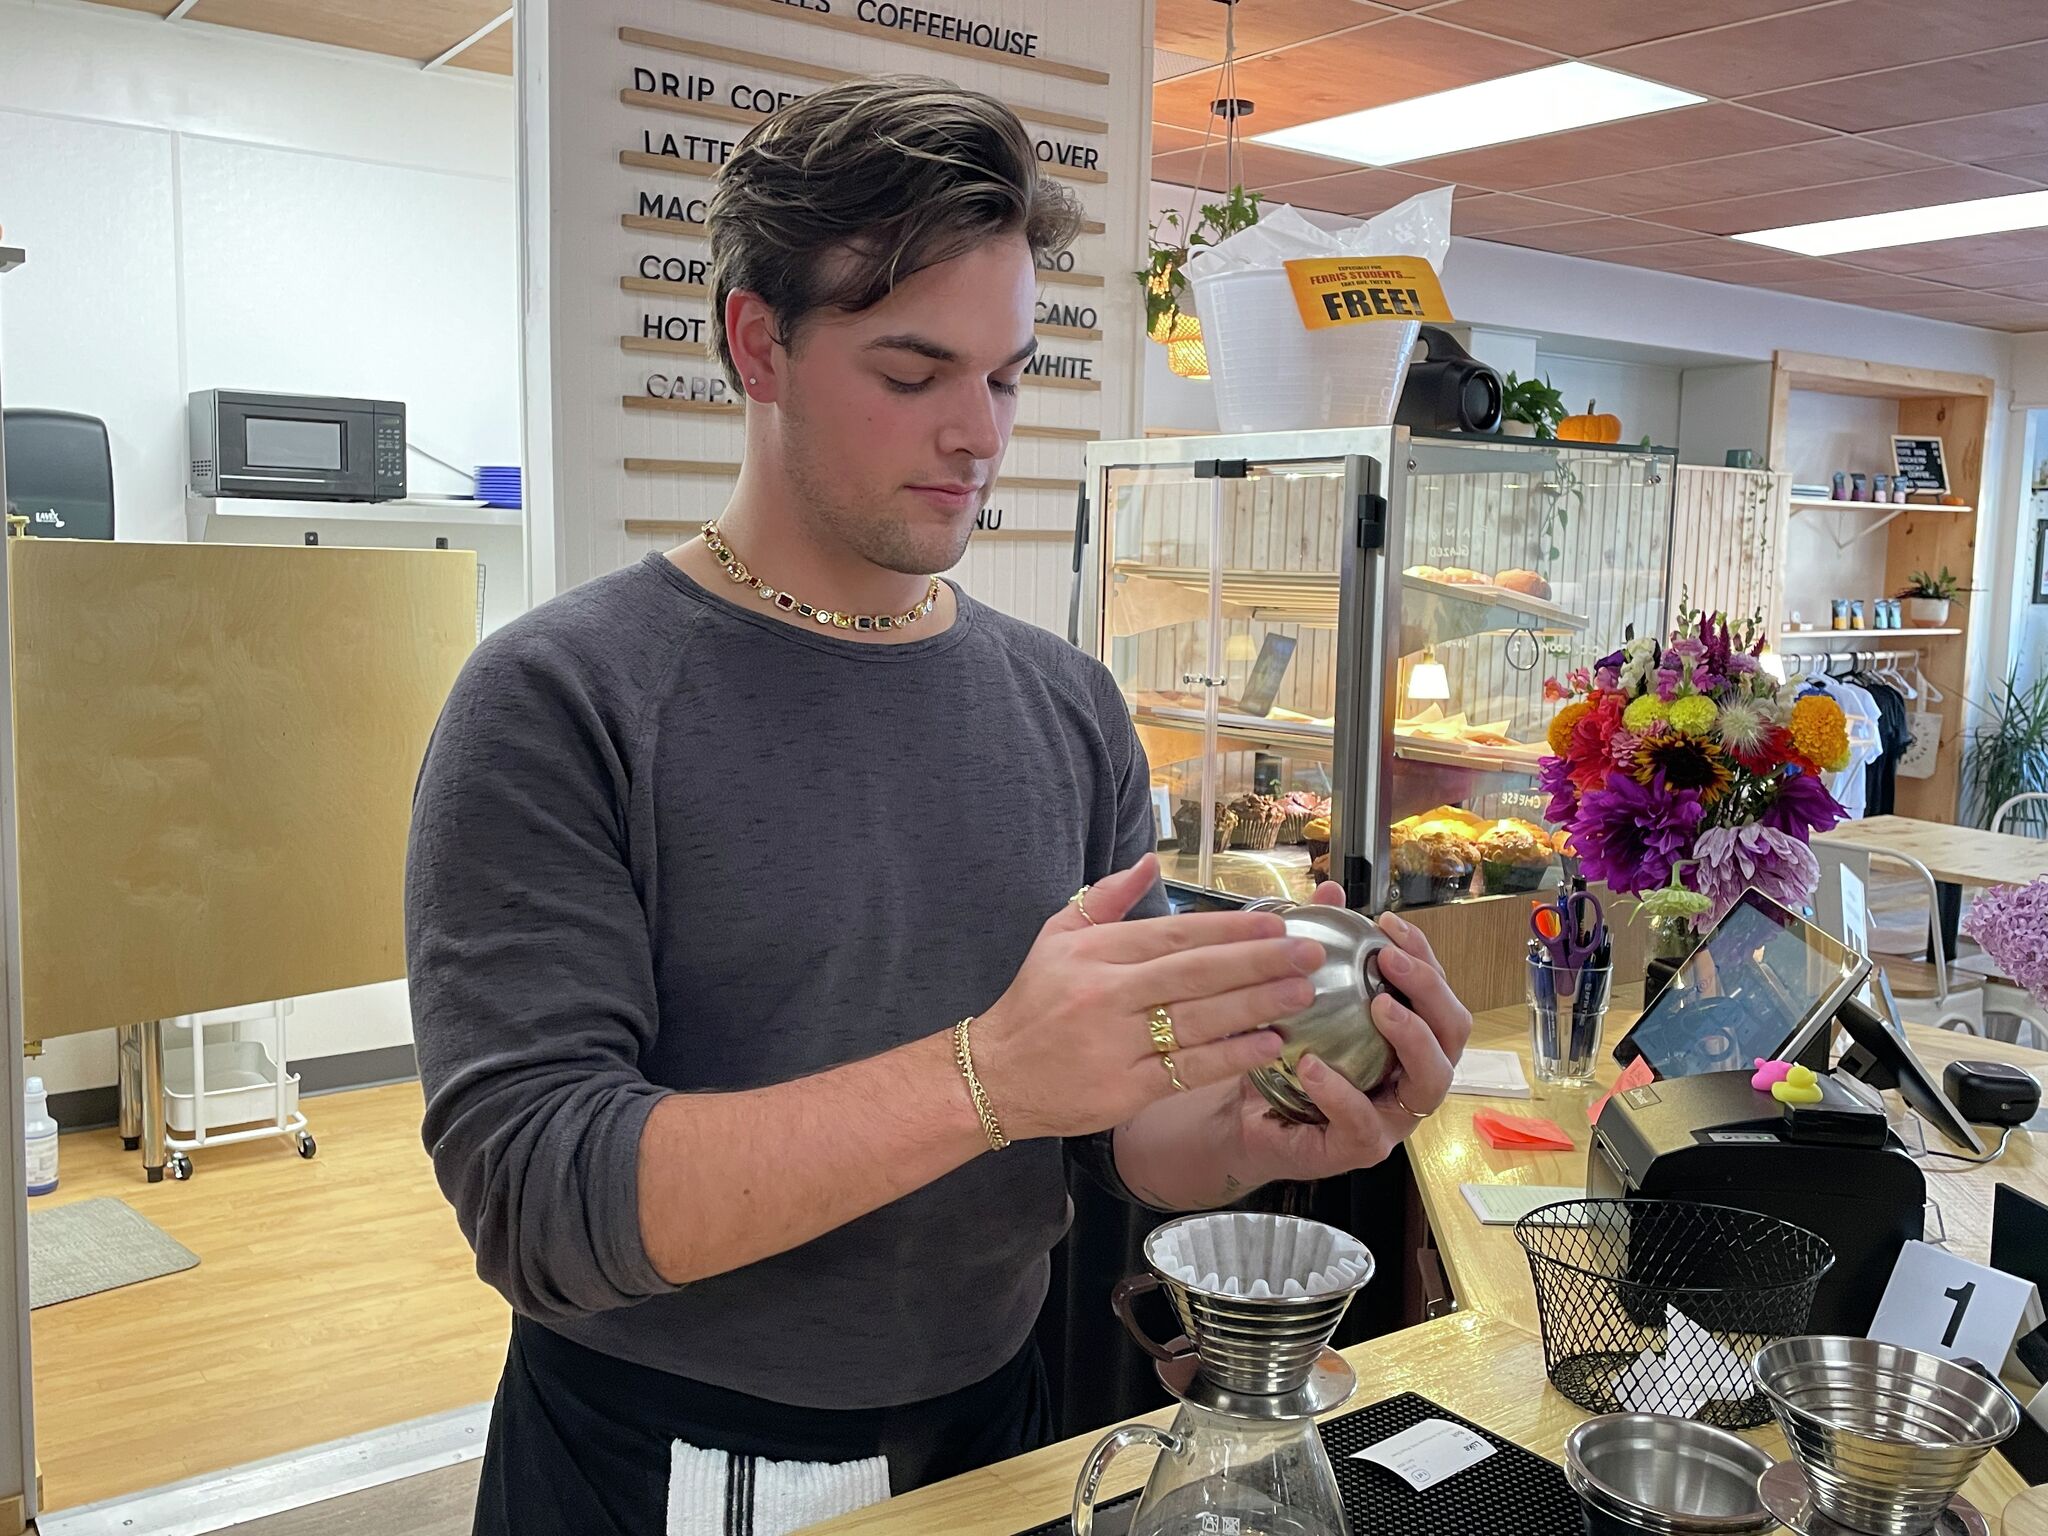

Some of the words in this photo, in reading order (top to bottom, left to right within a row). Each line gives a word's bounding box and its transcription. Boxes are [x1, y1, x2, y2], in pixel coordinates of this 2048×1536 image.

[857, 0, 1038, 58] COFFEEHOUSE
[634, 67, 715, 102] DRIP
[1035, 140, 1099, 171] OVER
[639, 255, 713, 285] COR
[1310, 271, 1347, 285] FERRIS
[1321, 288, 1425, 321] FREE!
[643, 313, 706, 343] HOT
[1023, 354, 1093, 381] WHITE
[1941, 1281, 1976, 1348] 1
